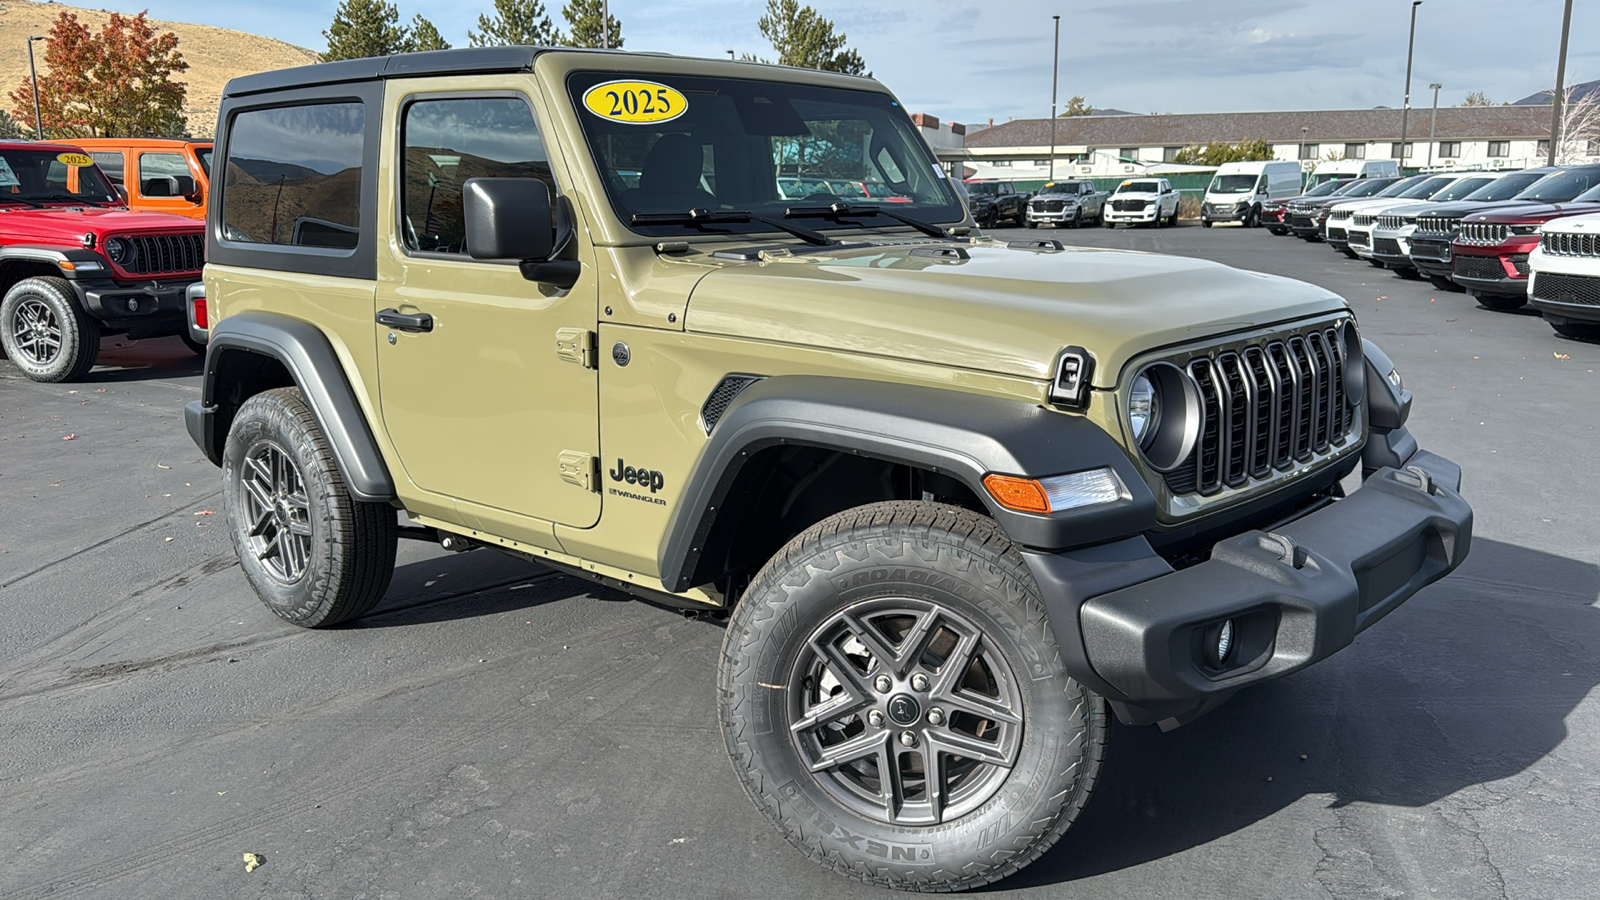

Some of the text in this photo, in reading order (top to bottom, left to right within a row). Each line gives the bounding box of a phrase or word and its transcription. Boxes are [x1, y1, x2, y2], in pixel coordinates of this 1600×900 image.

[606, 89, 670, 115] 2025
[64, 155, 88, 164] 2025
[609, 457, 664, 493] Jeep
[617, 490, 667, 506] WRANGLER
[976, 599, 1040, 662] HTX2
[1018, 751, 1053, 812] 245/75R17
[798, 800, 917, 862] NEXEN
